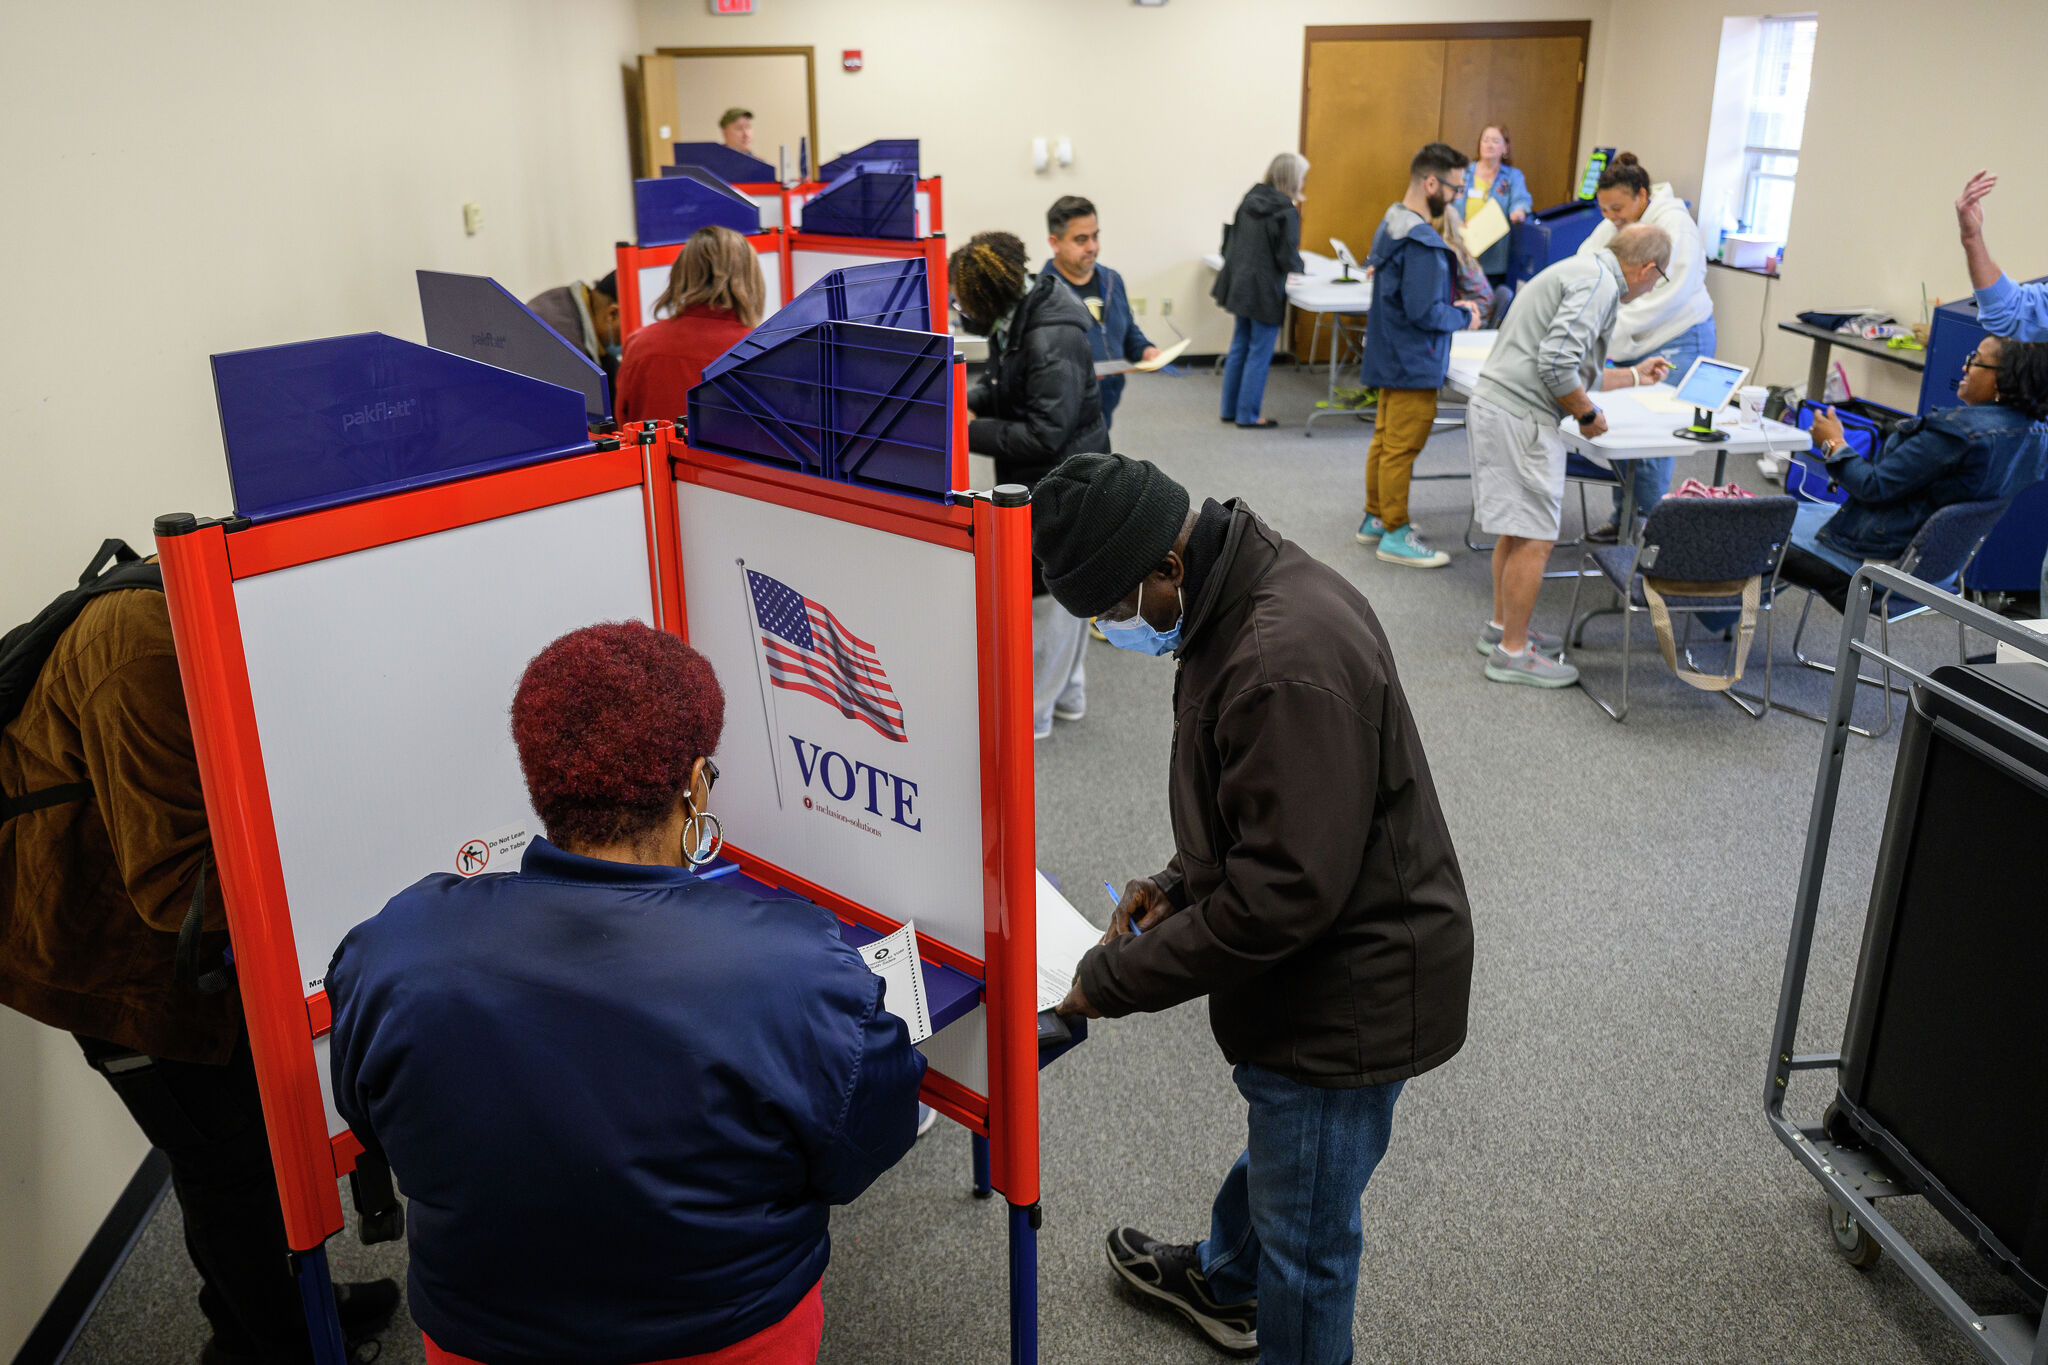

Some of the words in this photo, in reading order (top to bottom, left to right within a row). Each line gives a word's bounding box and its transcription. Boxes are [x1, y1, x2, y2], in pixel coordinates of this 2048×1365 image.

[789, 735, 921, 833] VOTE
[815, 802, 882, 837] inclusion-solutions
[489, 841, 498, 849] Do
[499, 836, 510, 845] Not
[511, 831, 525, 840] Lean
[510, 841, 526, 850] Table
[309, 978, 325, 988] Ma
